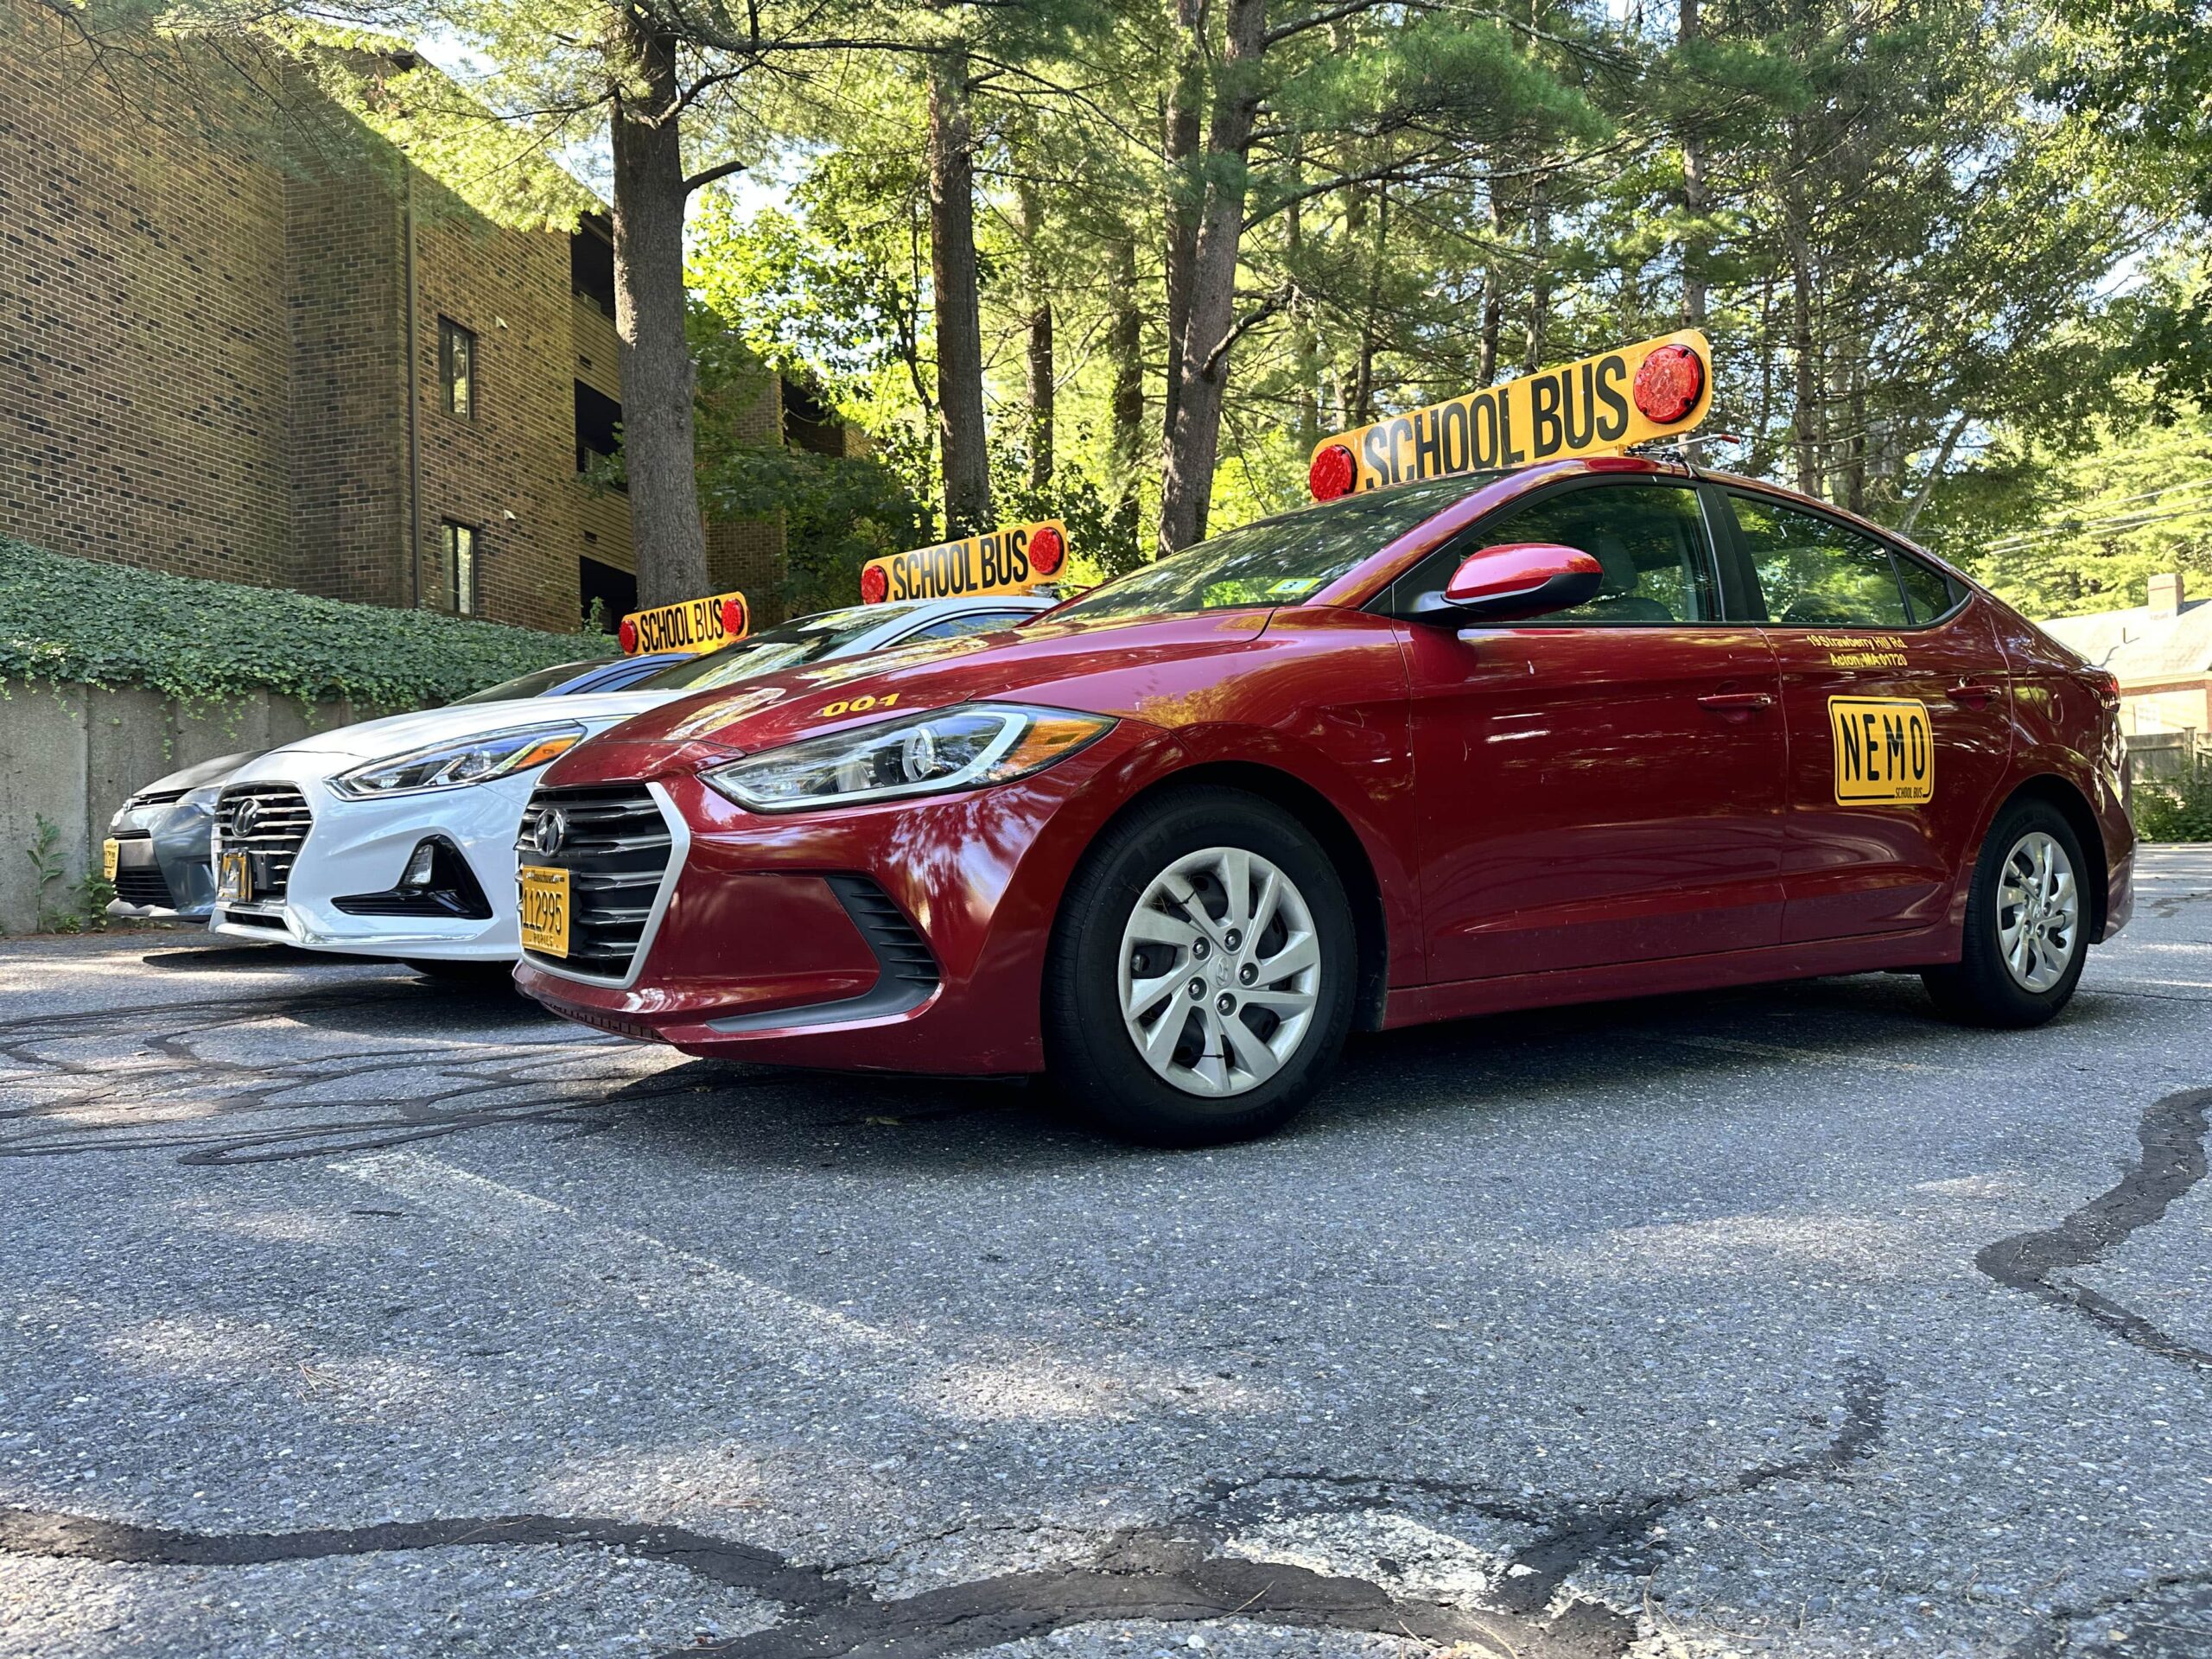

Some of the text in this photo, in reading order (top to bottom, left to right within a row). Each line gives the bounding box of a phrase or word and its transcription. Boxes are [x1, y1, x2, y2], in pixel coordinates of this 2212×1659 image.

[1363, 355, 1629, 490] SCHOOL BUS
[893, 530, 1028, 601] SCHOOL BUS
[640, 598, 724, 652] SCHOOL BUS
[1872, 636, 1891, 650] Hill
[1878, 653, 1909, 666] 01720
[823, 692, 900, 717] 001
[1840, 712, 1926, 781] NEMO
[1895, 786, 1923, 798] SCHOOL BUS
[523, 887, 563, 936] 112995
